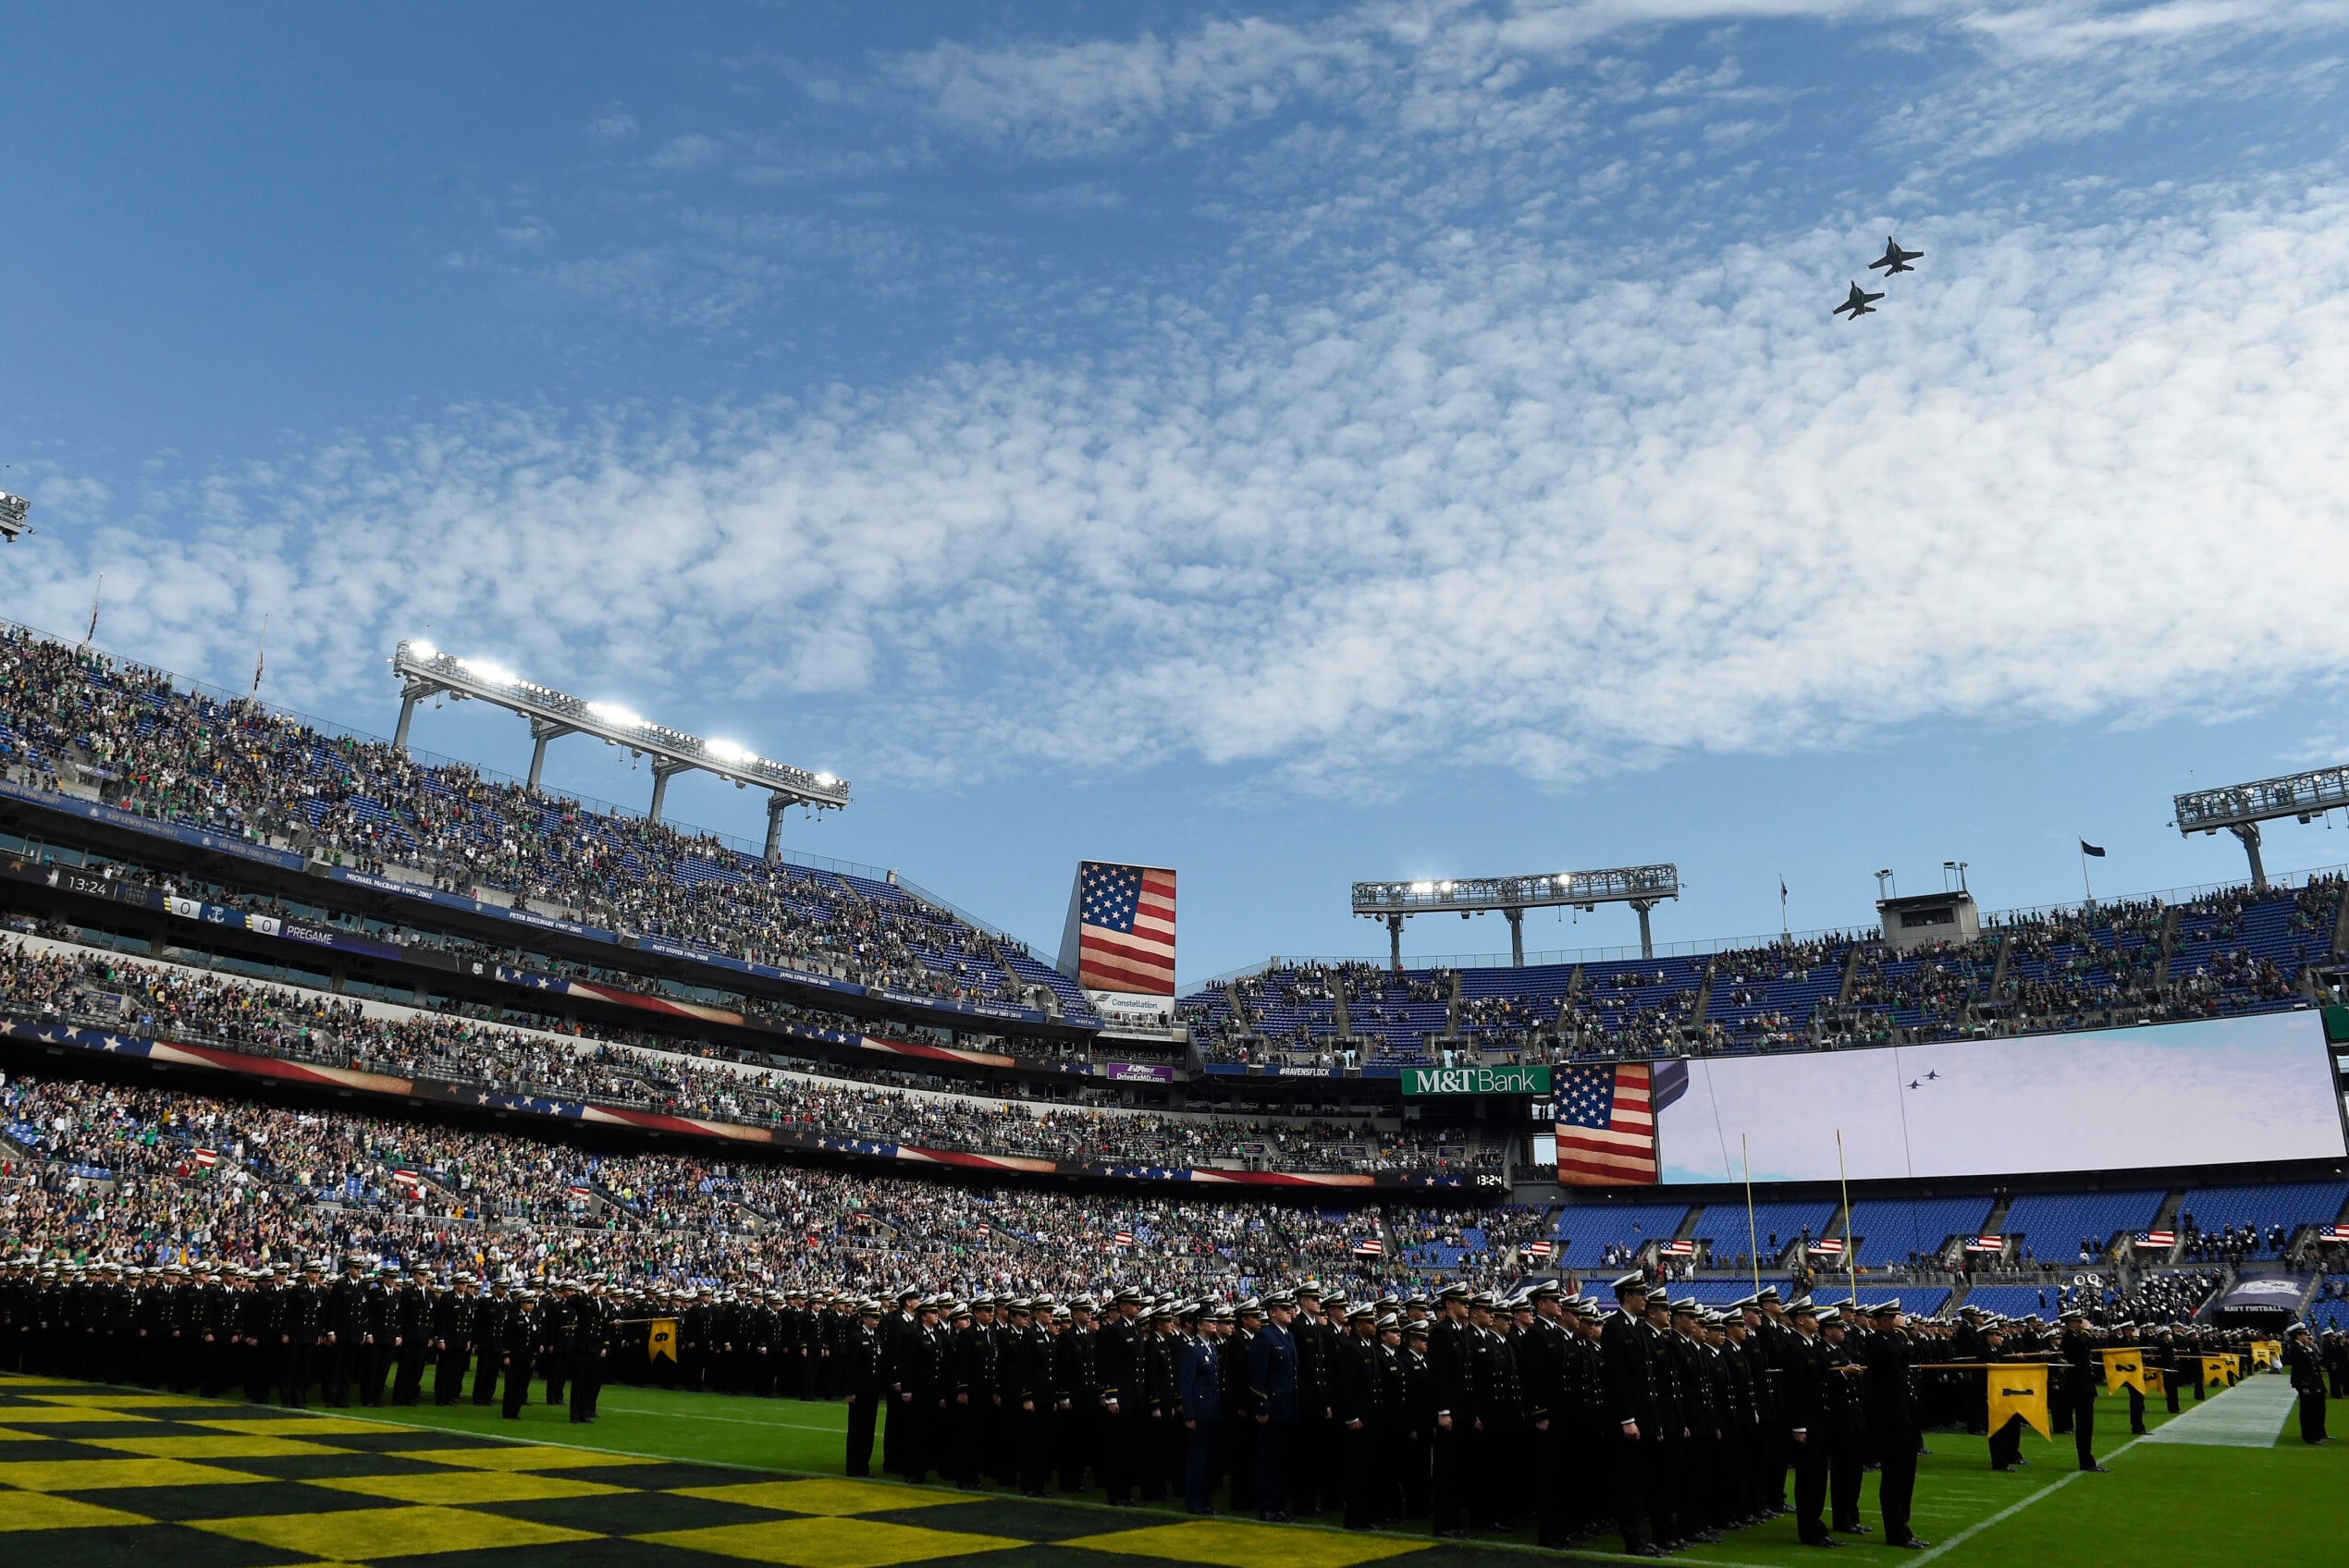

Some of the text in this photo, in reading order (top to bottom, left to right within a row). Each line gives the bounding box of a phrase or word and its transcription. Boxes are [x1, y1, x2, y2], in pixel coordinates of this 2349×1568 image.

[106, 813, 119, 821] RAY
[121, 816, 141, 827] LEWIS
[69, 876, 107, 896] 13:24
[346, 873, 373, 885] MICHAEL
[401, 887, 433, 900] 1997-2002
[509, 912, 526, 922] PETER
[286, 925, 333, 945] PREGAME
[652, 944, 665, 952] MATT
[1112, 998, 1158, 1010] Constellation
[1279, 1067, 1331, 1077] #RAVENSFLOCK
[1415, 1068, 1536, 1093] M&T Bank
[1476, 1174, 1502, 1186] 13:24
[2115, 1364, 2136, 1372] 2
[2002, 1388, 2034, 1397] 1
